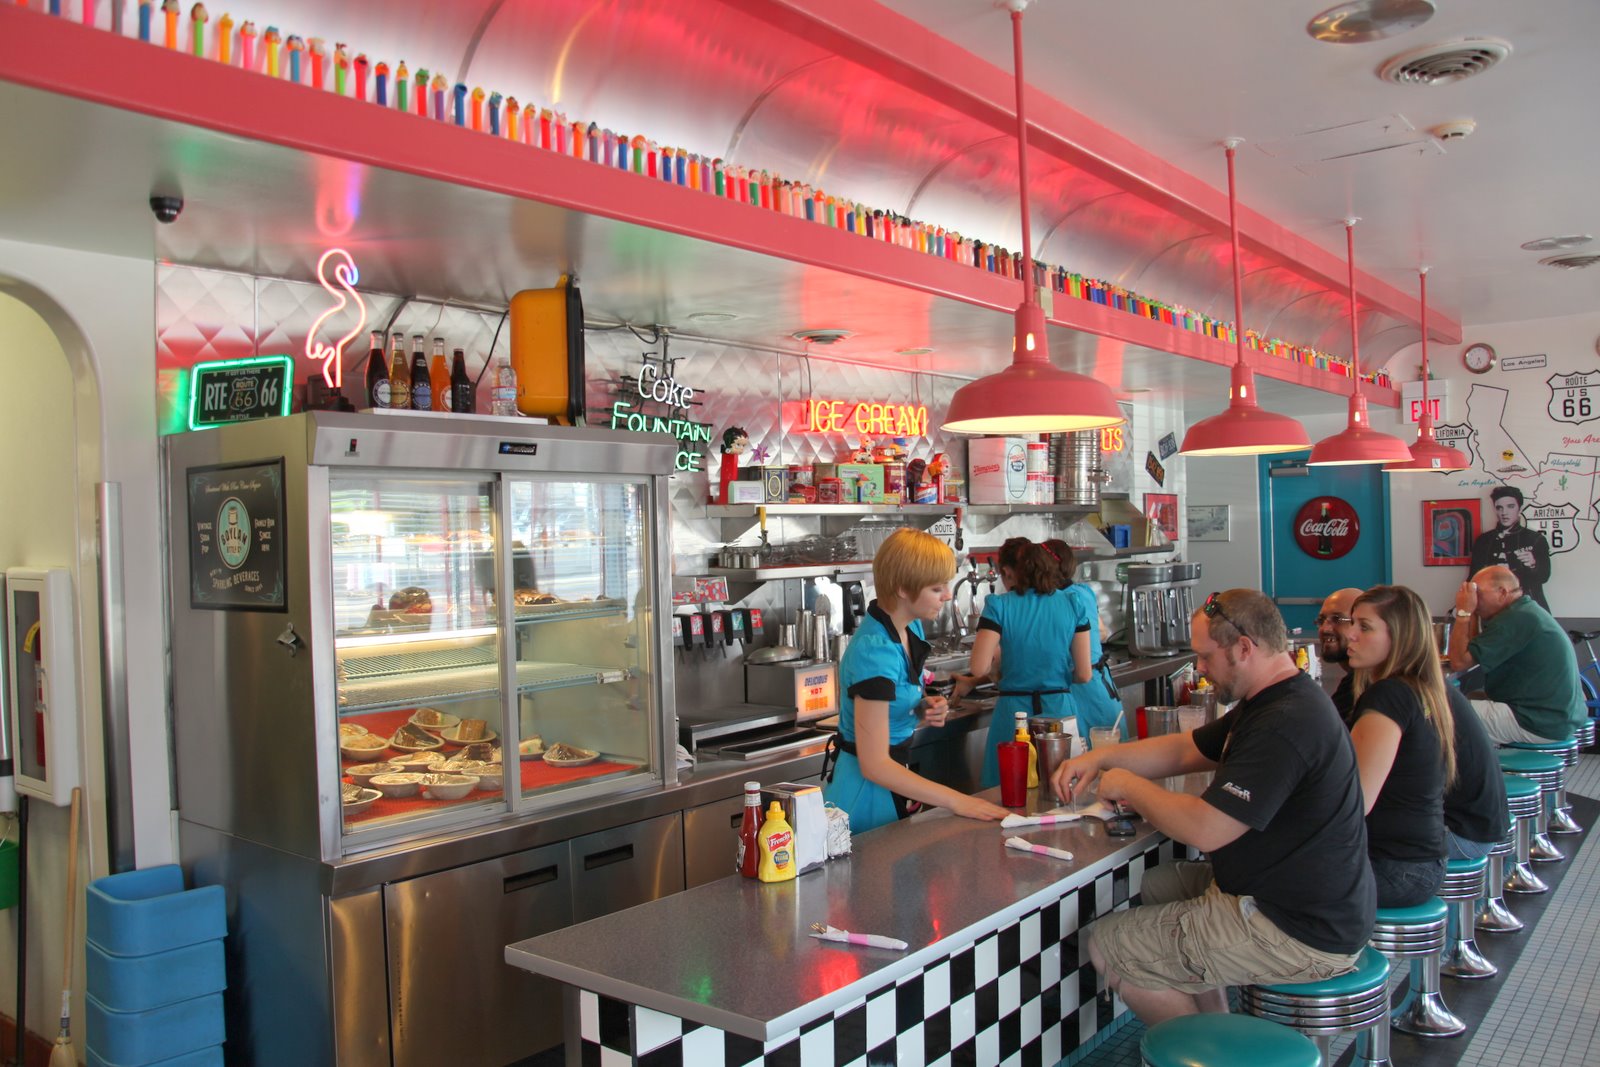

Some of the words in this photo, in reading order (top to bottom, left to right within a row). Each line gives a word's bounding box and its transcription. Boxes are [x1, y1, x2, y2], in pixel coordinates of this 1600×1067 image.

[235, 380, 255, 388] ROUTE
[638, 364, 694, 409] Coke
[1565, 376, 1588, 386] ROUTE
[204, 382, 228, 411] RTE
[261, 378, 278, 407] 66
[1563, 397, 1591, 417] 66
[612, 402, 711, 442] FOUNTAIN
[810, 400, 844, 432] ICE
[855, 403, 927, 437] CREAM
[1101, 427, 1123, 451] LTS
[1435, 429, 1465, 438] LIFORNIA
[1562, 436, 1581, 448] You
[1533, 507, 1565, 518] ARIZONA
[934, 524, 953, 533] ROUTE
[1300, 518, 1349, 537] Coca-Cola
[221, 527, 248, 545] BOYLAN
[233, 571, 260, 585] BEVERAGES
[810, 687, 822, 695] HOT
